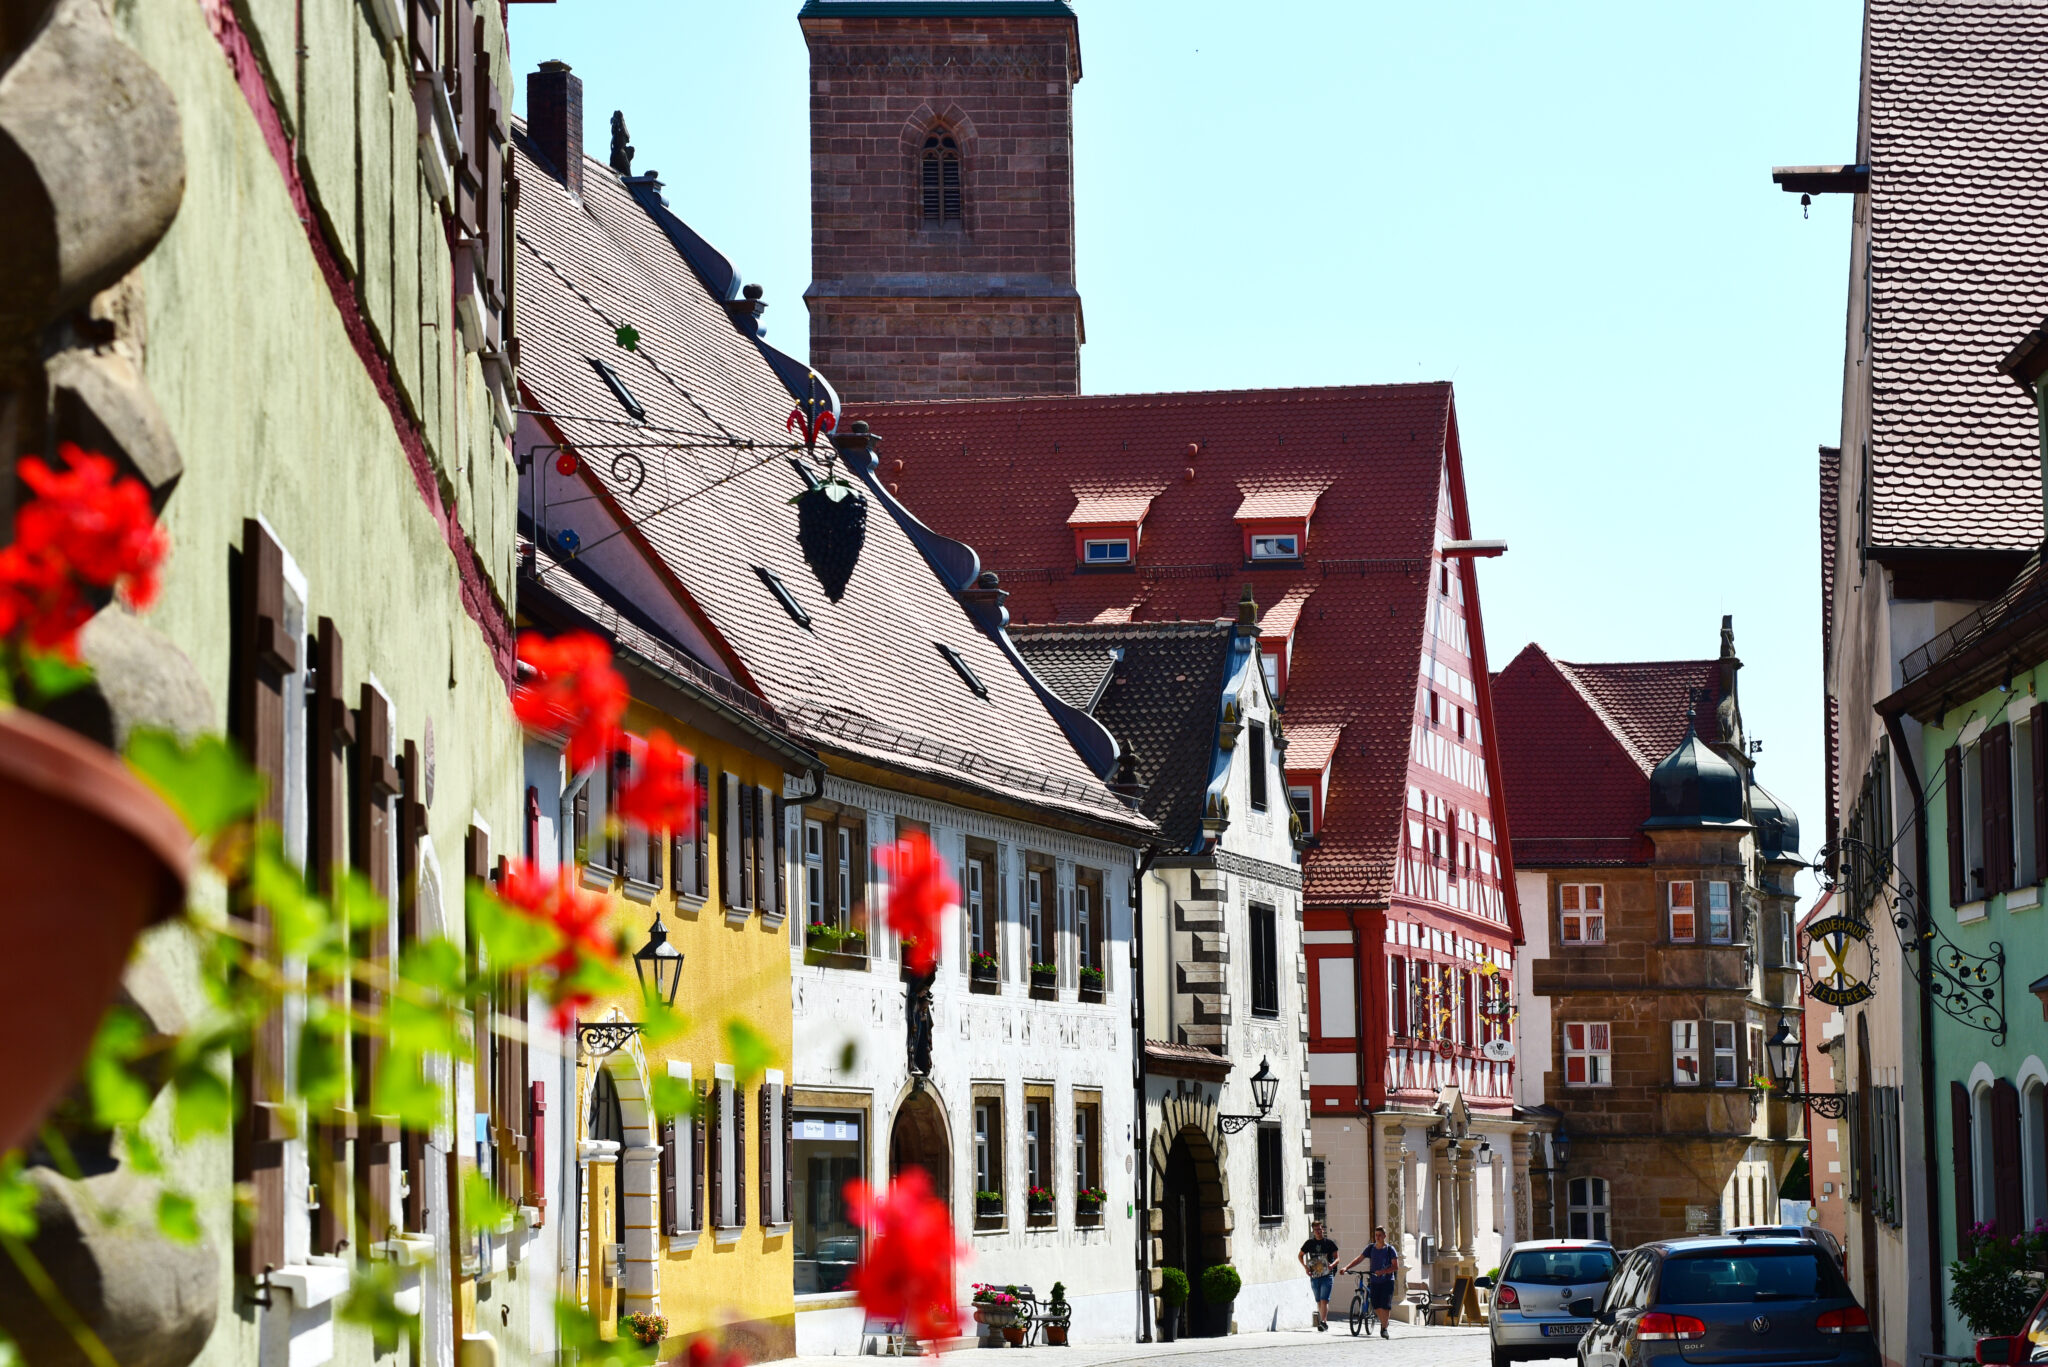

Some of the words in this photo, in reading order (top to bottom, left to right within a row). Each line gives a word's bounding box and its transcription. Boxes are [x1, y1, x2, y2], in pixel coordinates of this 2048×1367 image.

[1810, 919, 1868, 939] MODEHAUS
[1813, 985, 1869, 1003] LEDERER
[1549, 1326, 1560, 1334] AN
